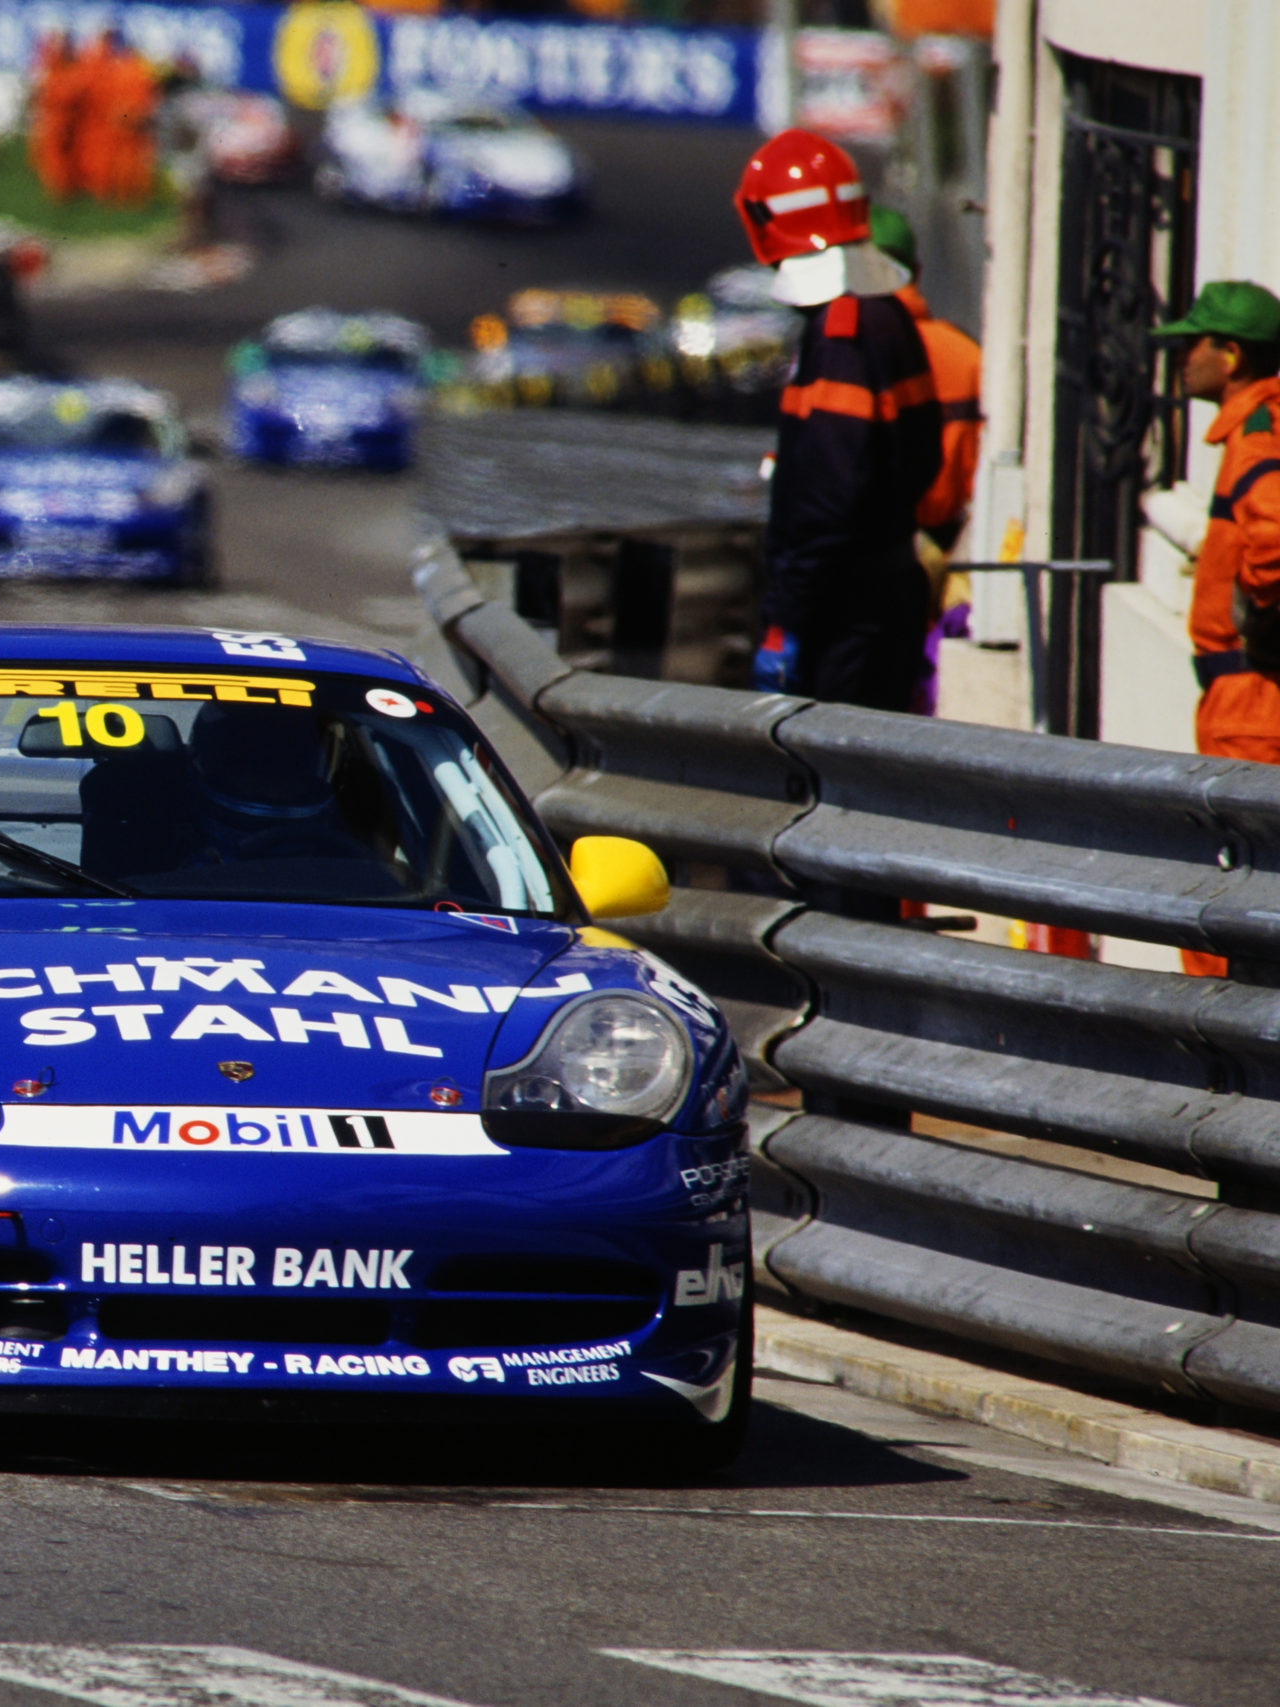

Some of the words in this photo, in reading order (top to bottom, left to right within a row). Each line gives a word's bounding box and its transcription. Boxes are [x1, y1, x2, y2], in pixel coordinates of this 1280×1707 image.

[37, 700, 146, 748] 10
[19, 1004, 444, 1058] STAHL
[111, 1110, 320, 1148] Mobil
[80, 1242, 257, 1287] HELLER
[271, 1247, 415, 1289] BANK
[59, 1347, 255, 1374] MANTHEY
[283, 1353, 432, 1377] RACING
[501, 1340, 632, 1367] MANAGEMENT
[526, 1363, 621, 1386] ENGINEERS
